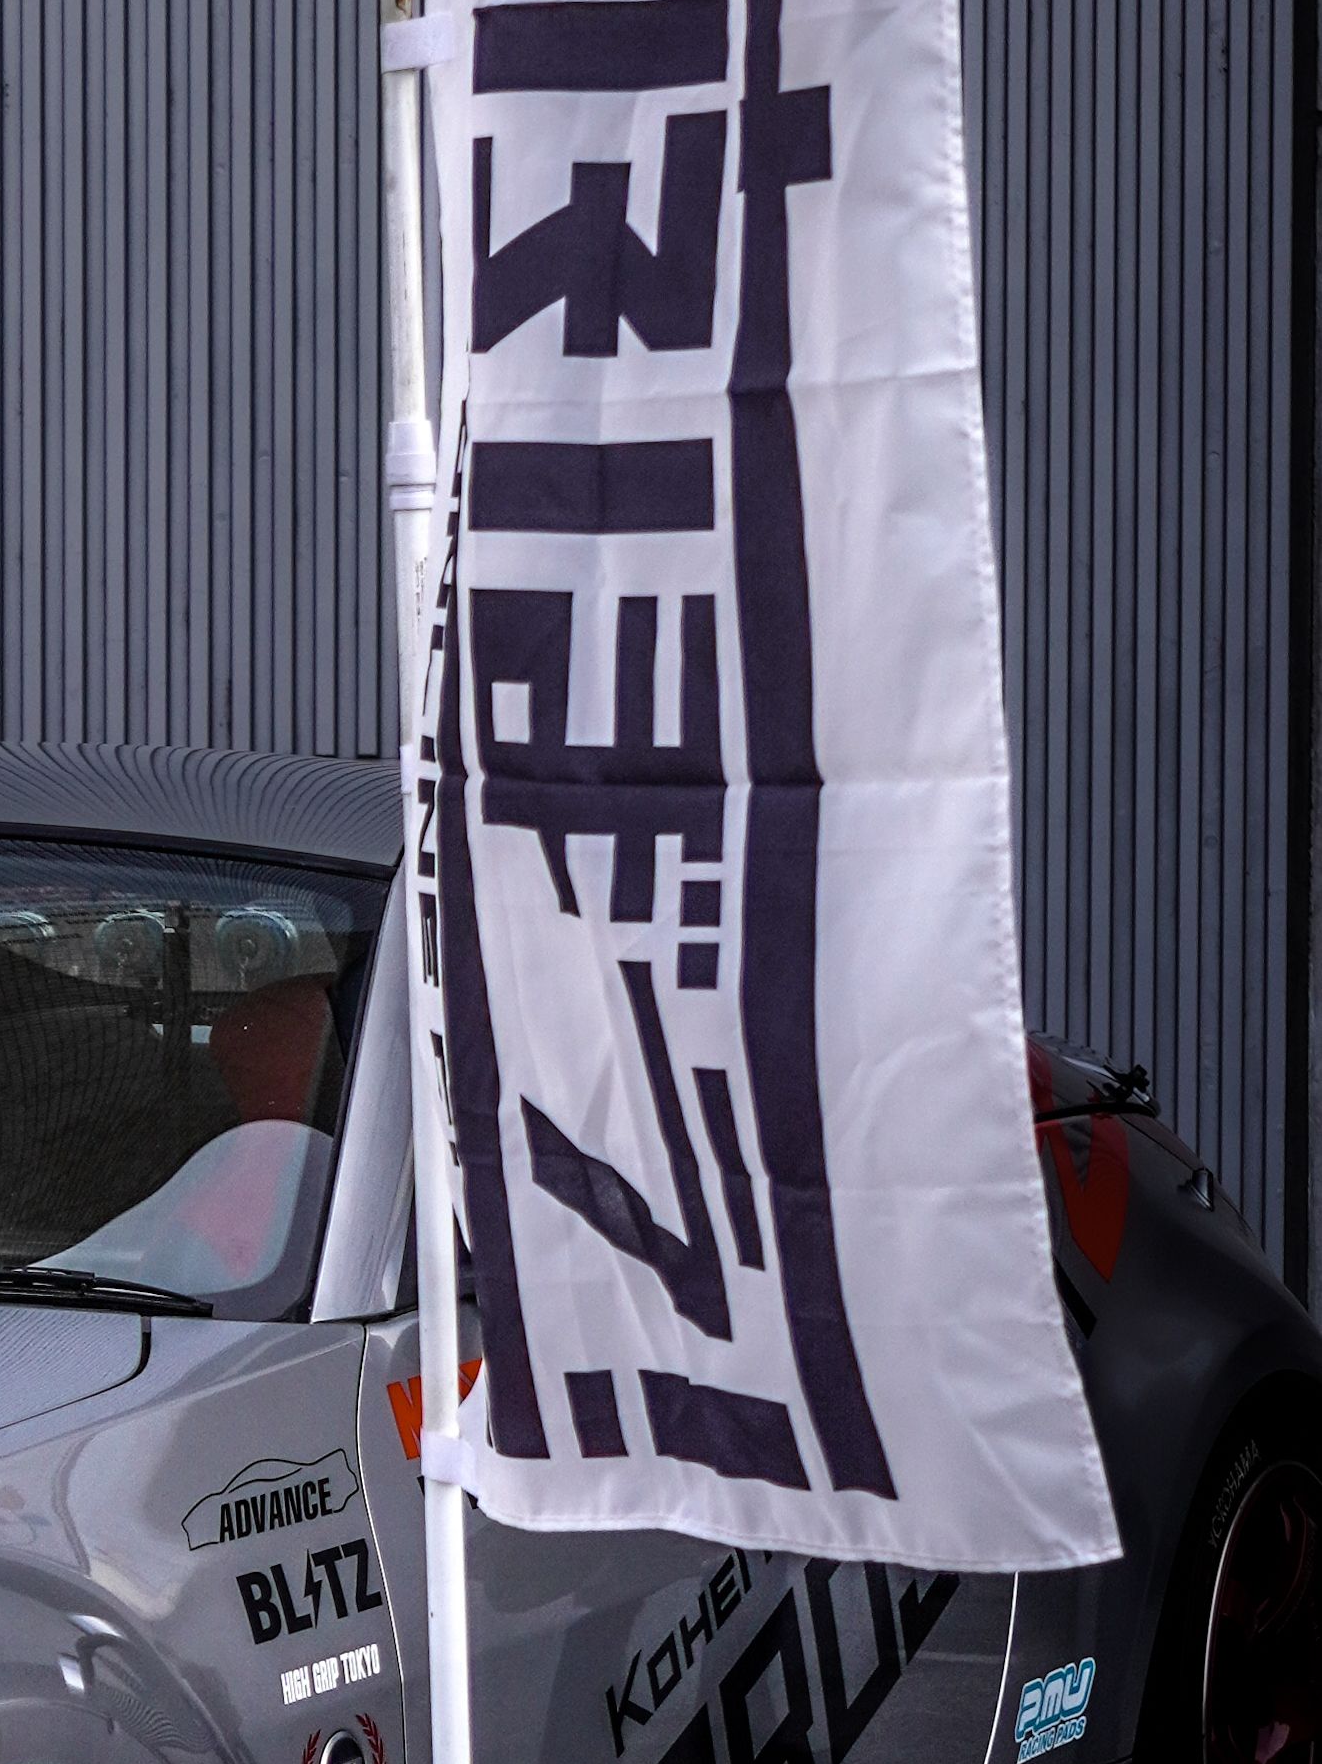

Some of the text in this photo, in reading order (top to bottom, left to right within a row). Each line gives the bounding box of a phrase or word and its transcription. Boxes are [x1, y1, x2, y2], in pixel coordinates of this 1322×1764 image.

[219, 1477, 334, 1543] ADVANCE
[280, 1643, 382, 1705] HIGH GRIP TOKYO
[1055, 1716, 1086, 1749] PADS
